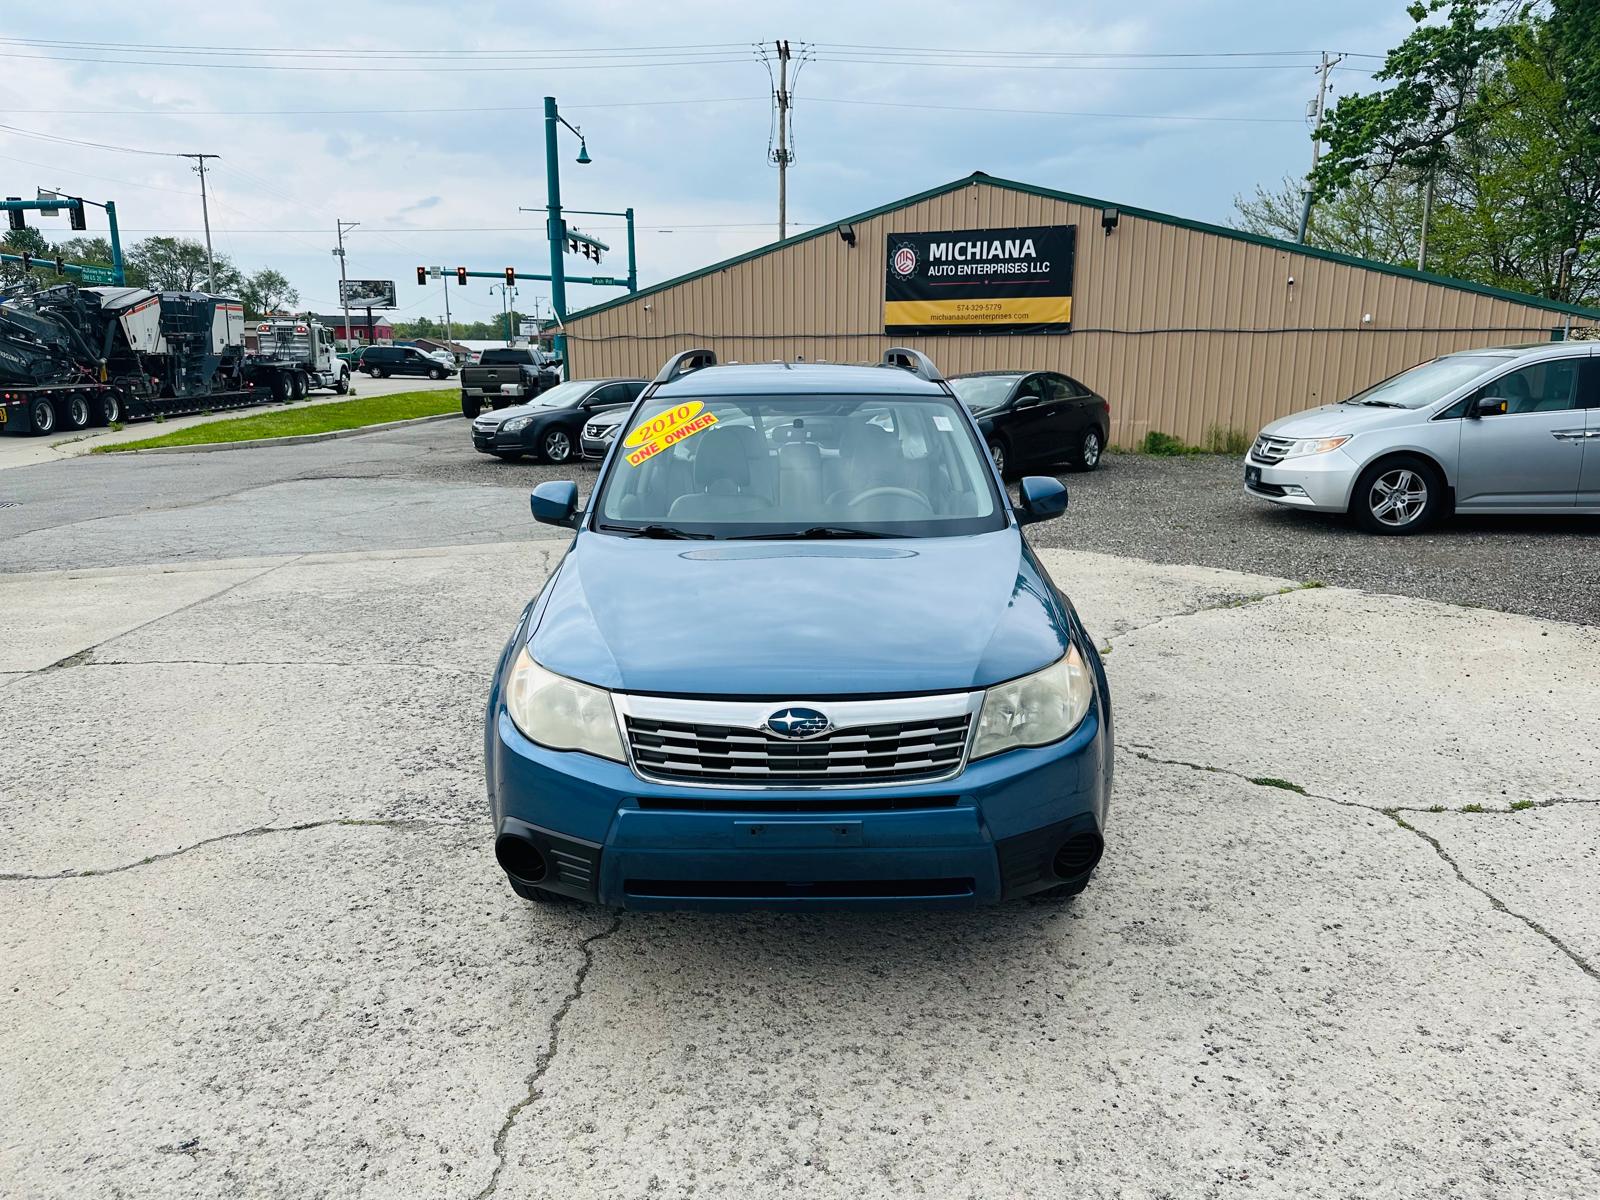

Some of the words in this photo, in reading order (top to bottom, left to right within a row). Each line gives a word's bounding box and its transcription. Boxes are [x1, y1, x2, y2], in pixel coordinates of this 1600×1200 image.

[929, 239, 1037, 262] MICHIANA
[928, 265, 956, 276] AUTO
[957, 262, 1028, 275] ENTERPRISES
[1030, 261, 1050, 273] LLC
[930, 312, 1029, 321] michianaautoenterprises.com
[956, 303, 1002, 312] 574-329-5779
[639, 406, 690, 442] 2010
[630, 441, 660, 464] ONE
[664, 414, 715, 444] OWNER
